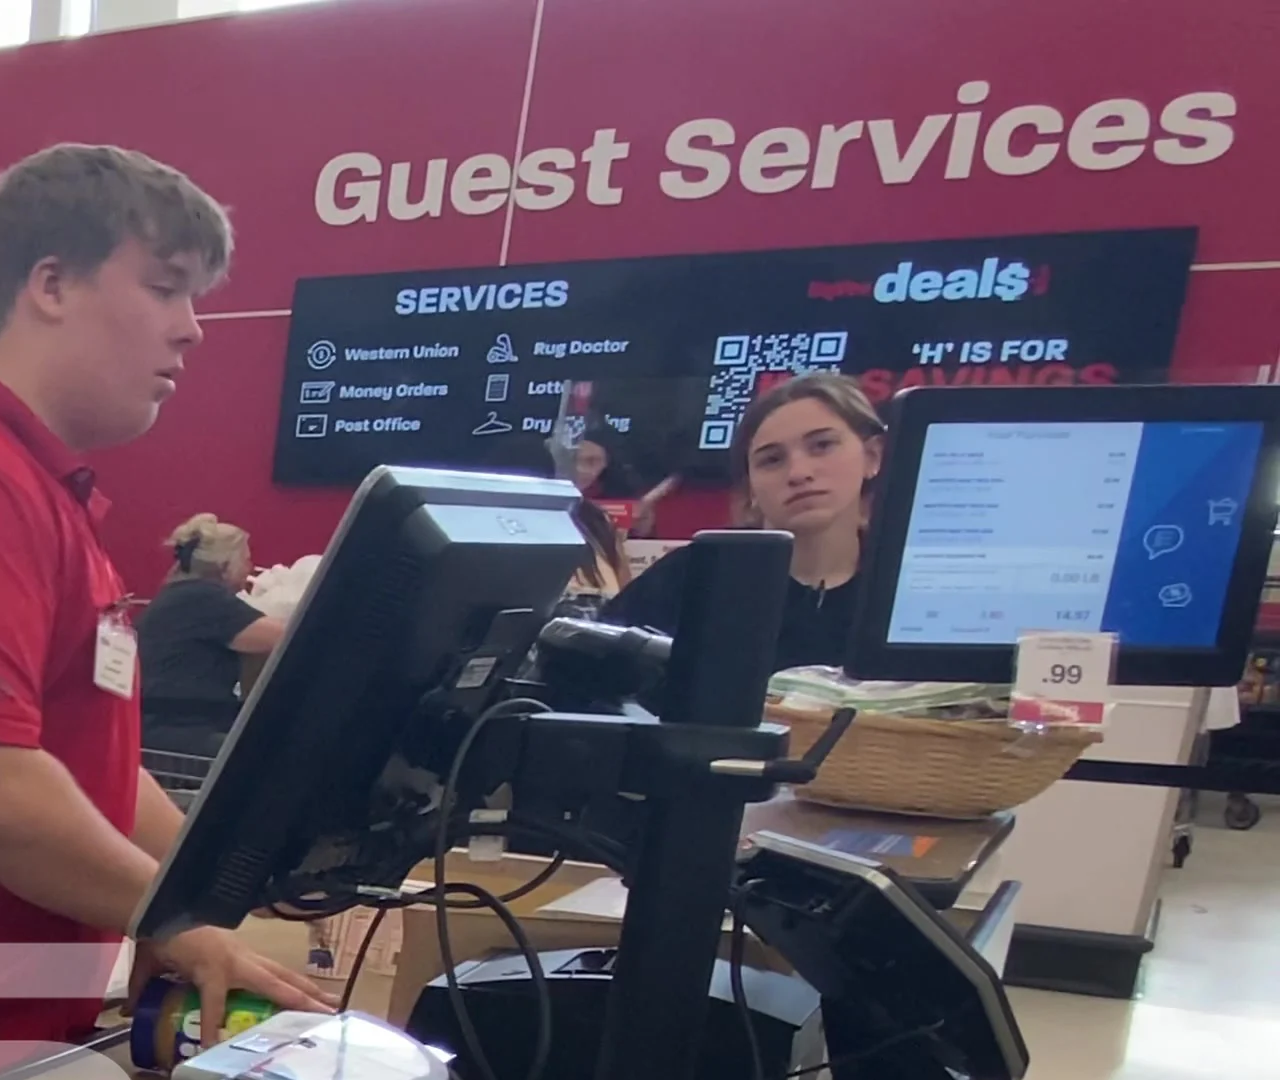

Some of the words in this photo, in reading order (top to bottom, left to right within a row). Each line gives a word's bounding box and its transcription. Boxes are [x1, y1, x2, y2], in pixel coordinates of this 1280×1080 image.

[313, 127, 630, 227] Guest
[658, 80, 1236, 200] Services
[395, 280, 568, 315] SERVICES
[345, 347, 409, 361] Western
[414, 344, 459, 358] Union
[534, 342, 565, 358] Rug
[570, 340, 629, 354] Doctor
[960, 341, 992, 362] IS
[1000, 339, 1068, 362] FOR
[339, 385, 392, 401] Money
[396, 383, 448, 397] Orders
[335, 419, 370, 432] Post
[373, 417, 420, 431] Office
[523, 417, 552, 432] Dry
[1042, 664, 1082, 685] .99
